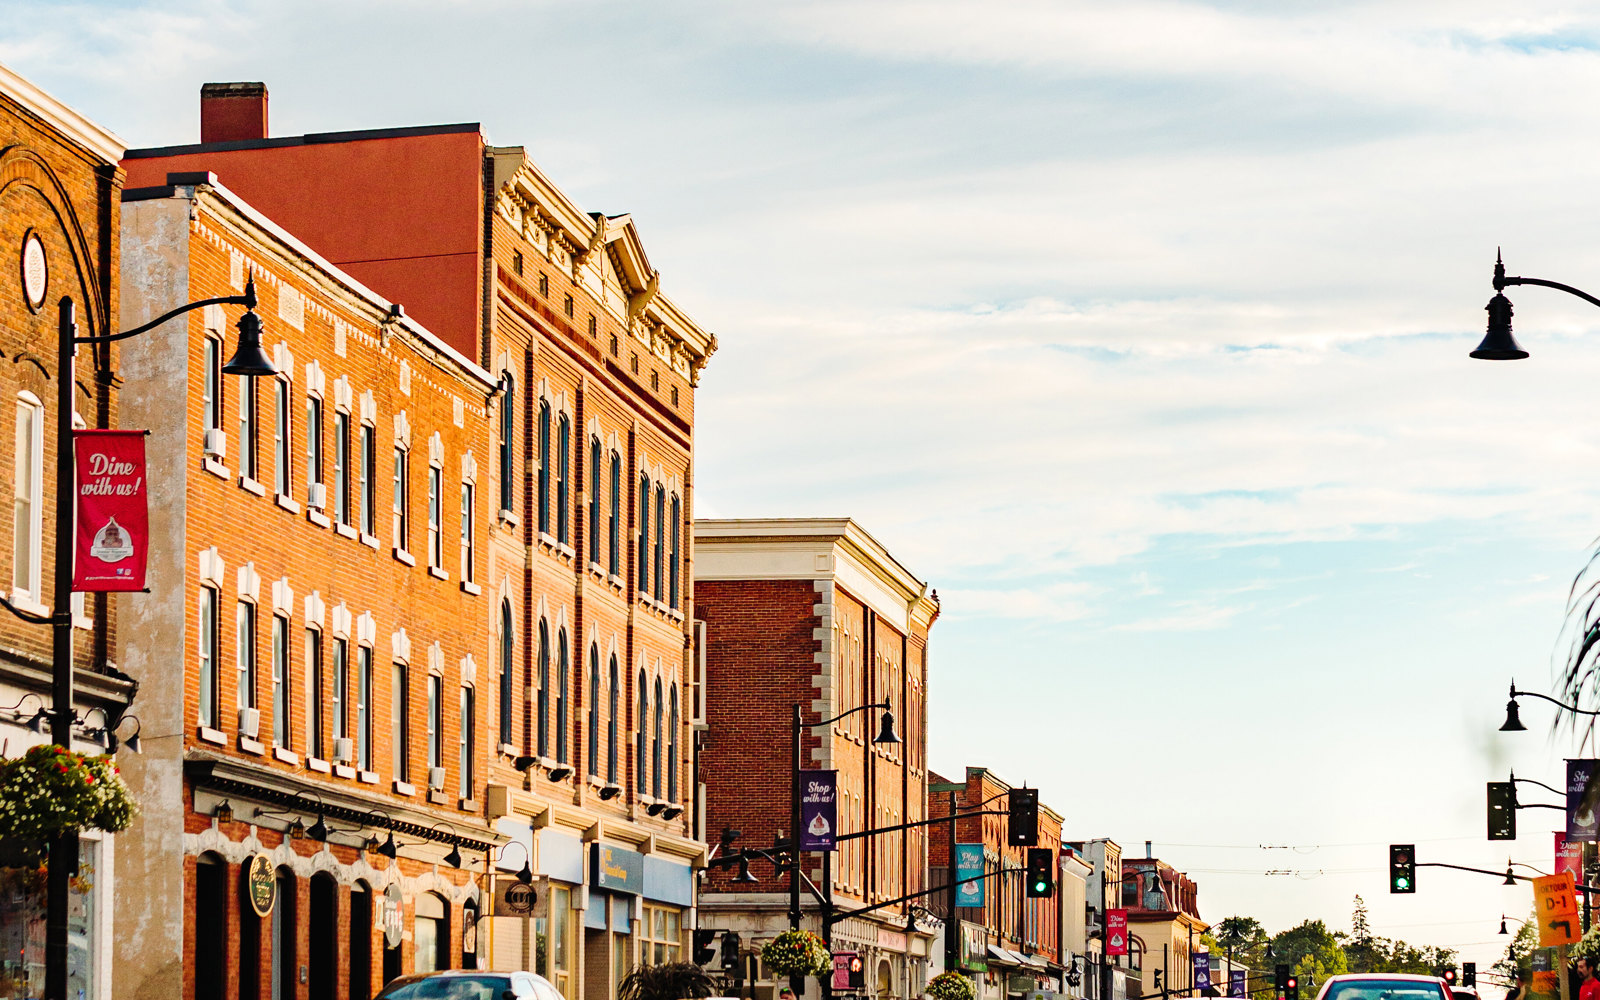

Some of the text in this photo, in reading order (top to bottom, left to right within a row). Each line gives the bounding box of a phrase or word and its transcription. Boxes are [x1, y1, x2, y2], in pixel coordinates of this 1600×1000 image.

[89, 453, 136, 476] Dine
[81, 476, 142, 496] with us!
[808, 781, 831, 795] Shop
[1568, 783, 1585, 793] with
[803, 792, 835, 803] with us!
[961, 852, 980, 864] Play
[958, 861, 982, 869] with us!
[1546, 896, 1567, 910] D-1
